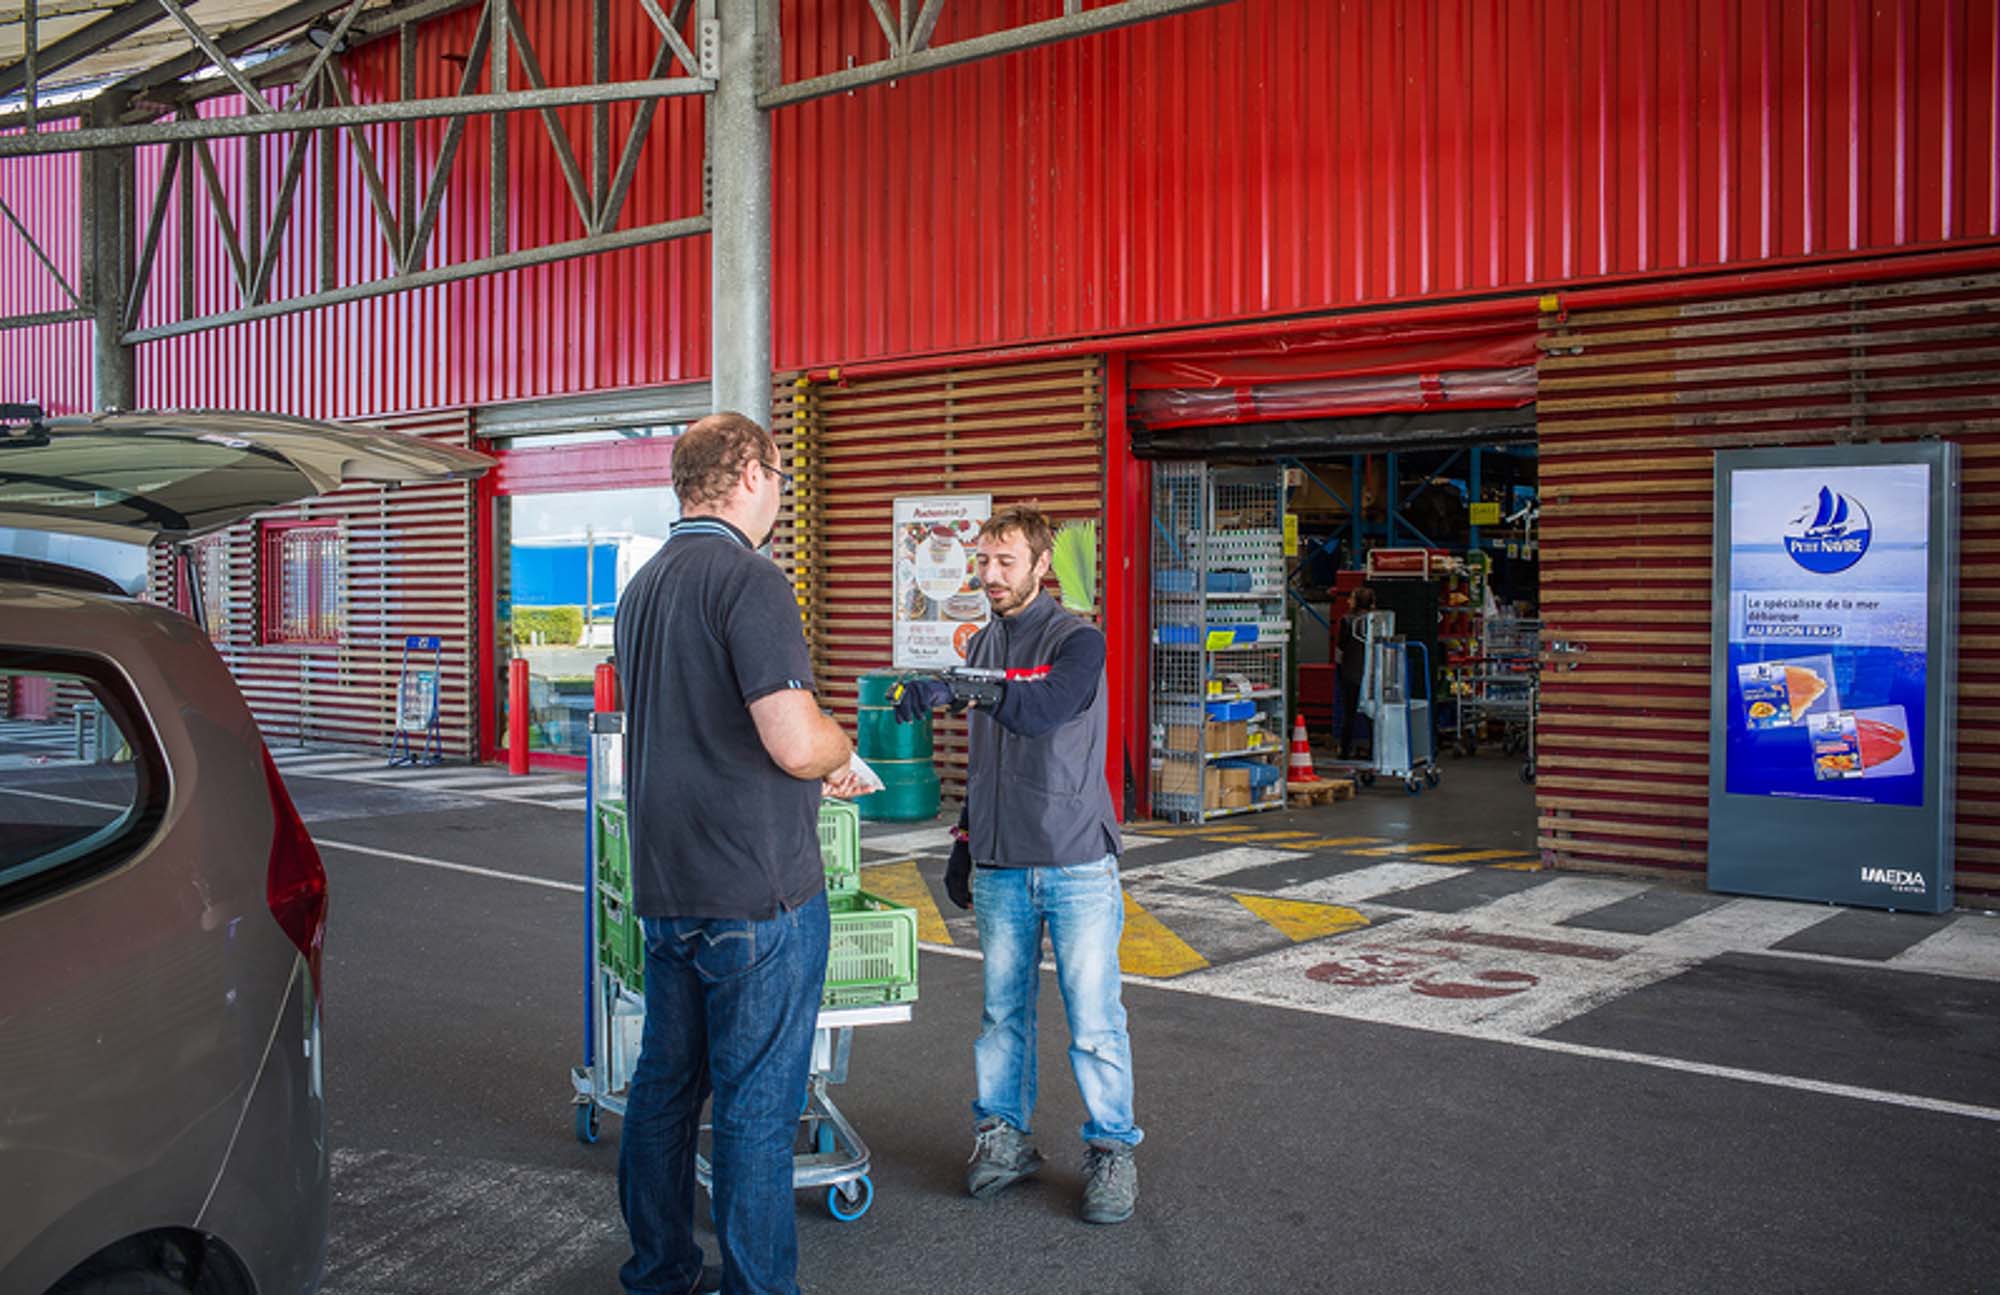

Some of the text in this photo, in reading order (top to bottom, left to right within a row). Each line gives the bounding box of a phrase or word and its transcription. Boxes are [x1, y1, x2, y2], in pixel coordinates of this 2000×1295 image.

[1748, 598, 1880, 610] Le spécialiste de la mer
[1748, 611, 1800, 623] débarque
[1748, 626, 1841, 637] AU RAYON FRAIS
